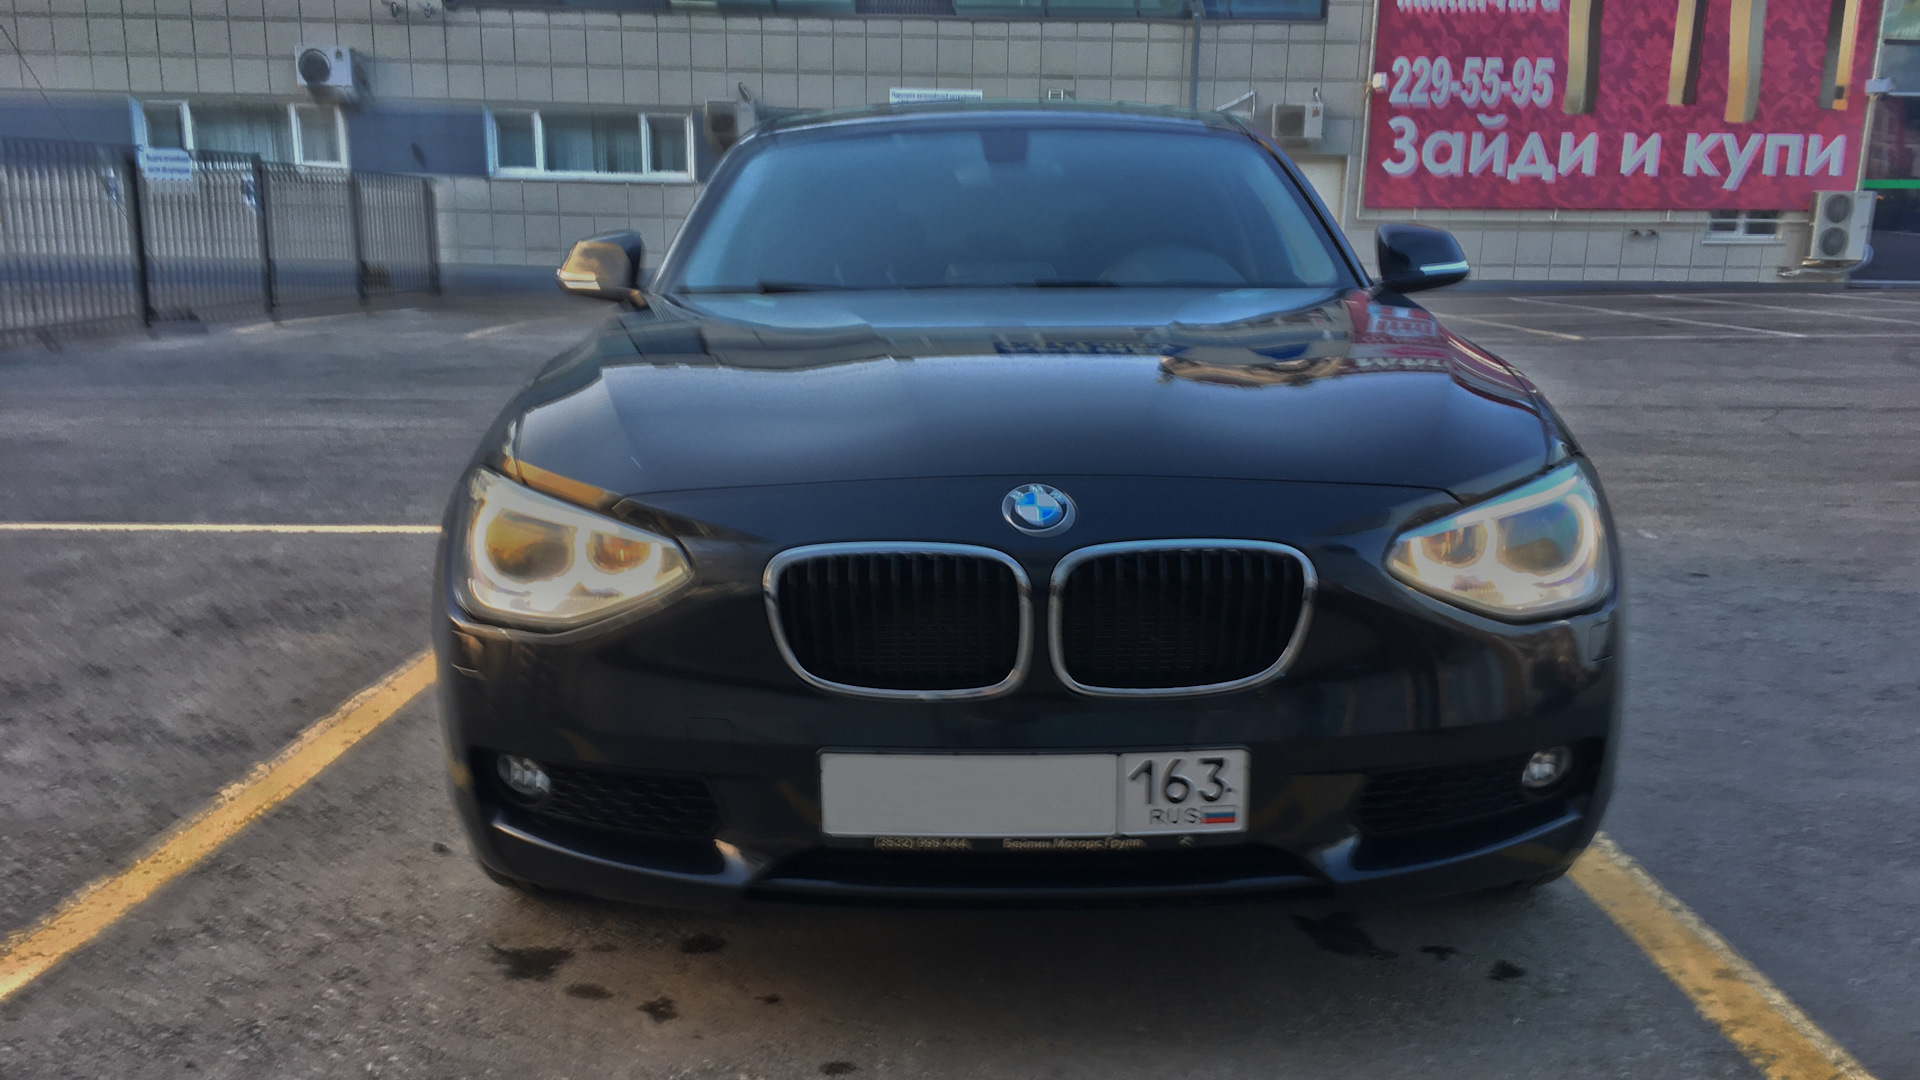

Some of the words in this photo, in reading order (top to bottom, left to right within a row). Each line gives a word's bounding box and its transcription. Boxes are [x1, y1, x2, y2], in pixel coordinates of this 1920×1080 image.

[1389, 56, 1555, 109] 229-55-95
[1381, 114, 1600, 183] Зайди
[1620, 132, 1662, 177] и
[1683, 132, 1848, 191] купи
[1127, 757, 1225, 804] 163
[1149, 807, 1201, 825] RUS
